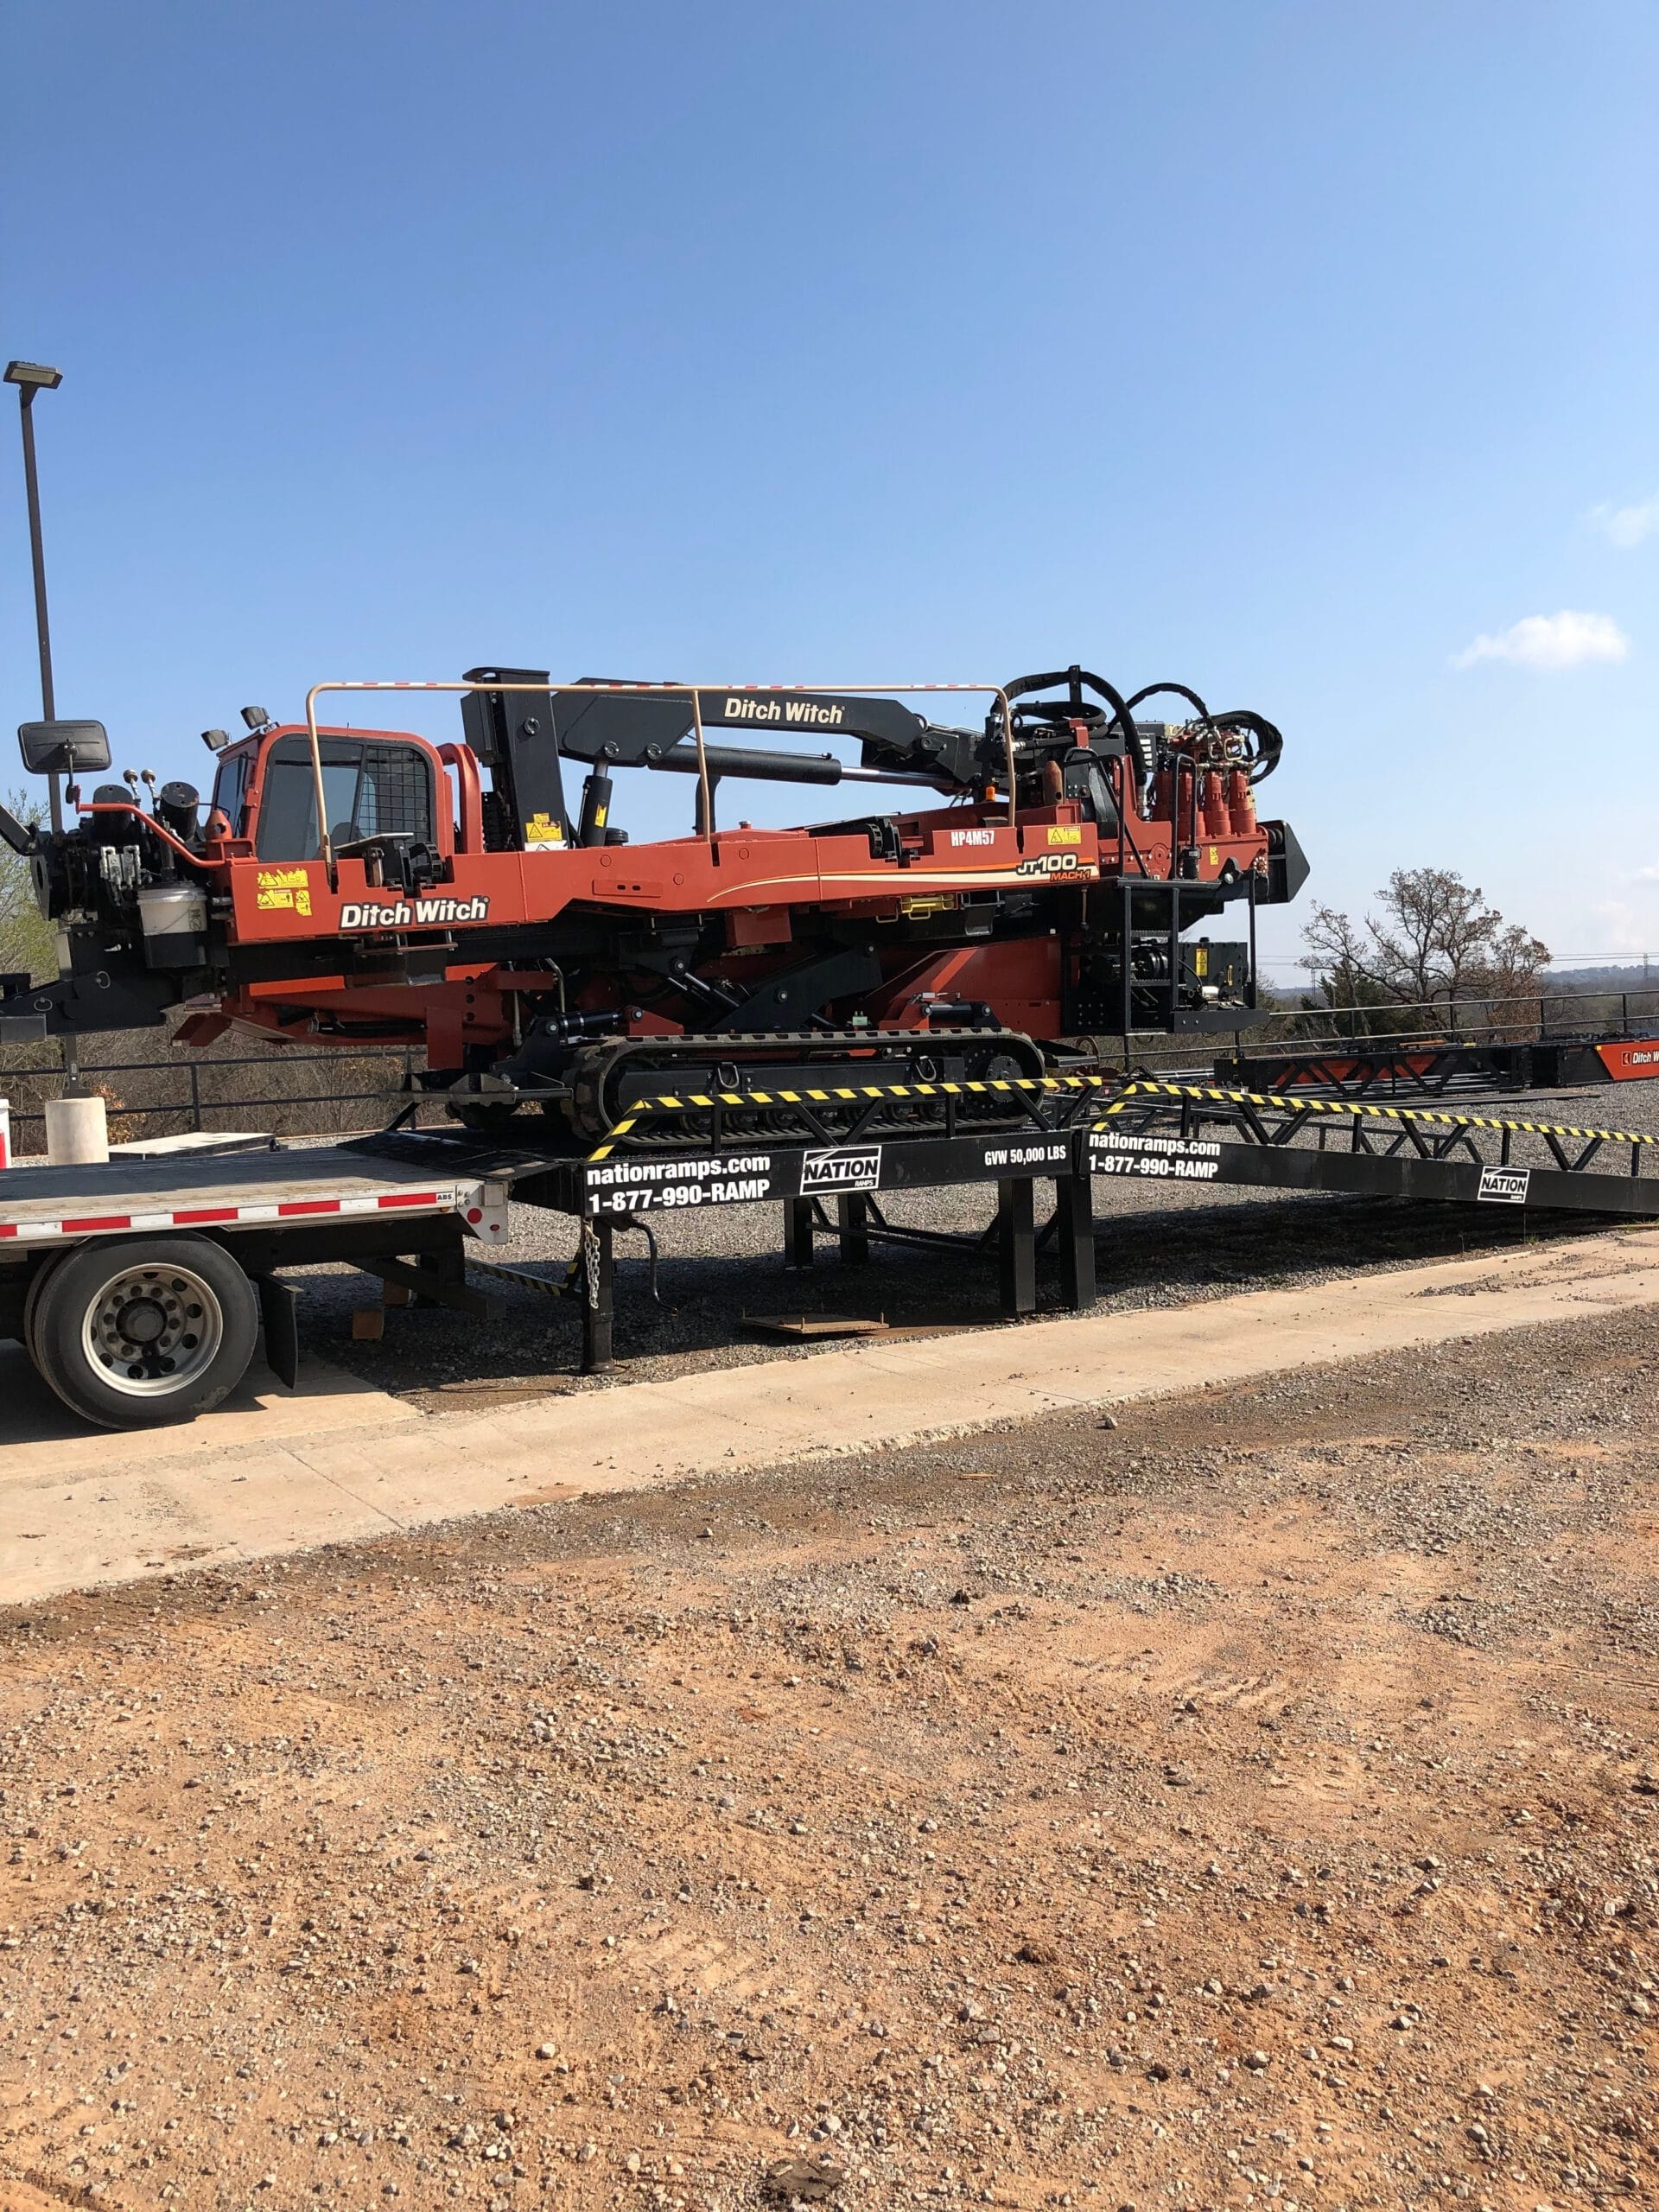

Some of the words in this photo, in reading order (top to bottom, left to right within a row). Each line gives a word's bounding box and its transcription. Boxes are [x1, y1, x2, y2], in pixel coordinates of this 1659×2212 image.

[724, 697, 781, 721] Ditch
[785, 702, 843, 724] Witch
[950, 830, 995, 847] HP4M57
[1017, 854, 1077, 874] JT100
[1051, 871, 1082, 880] MACH
[1084, 869, 1090, 879] 1
[340, 901, 410, 928] Ditch
[416, 896, 486, 923] Witch
[1632, 1052, 1652, 1064] Ditch
[1089, 1132, 1220, 1156] nationramps.com
[985, 1150, 1007, 1166] GVW
[1010, 1147, 1045, 1166] 50,000
[1047, 1145, 1066, 1160] LBS
[1089, 1154, 1218, 1178] 1-877-990-RAMP
[587, 1156, 771, 1185] nationramps.com
[804, 1160, 878, 1181] NATION
[1481, 1177, 1527, 1192] NATION
[588, 1179, 771, 1213] 1-877-990-RAMP
